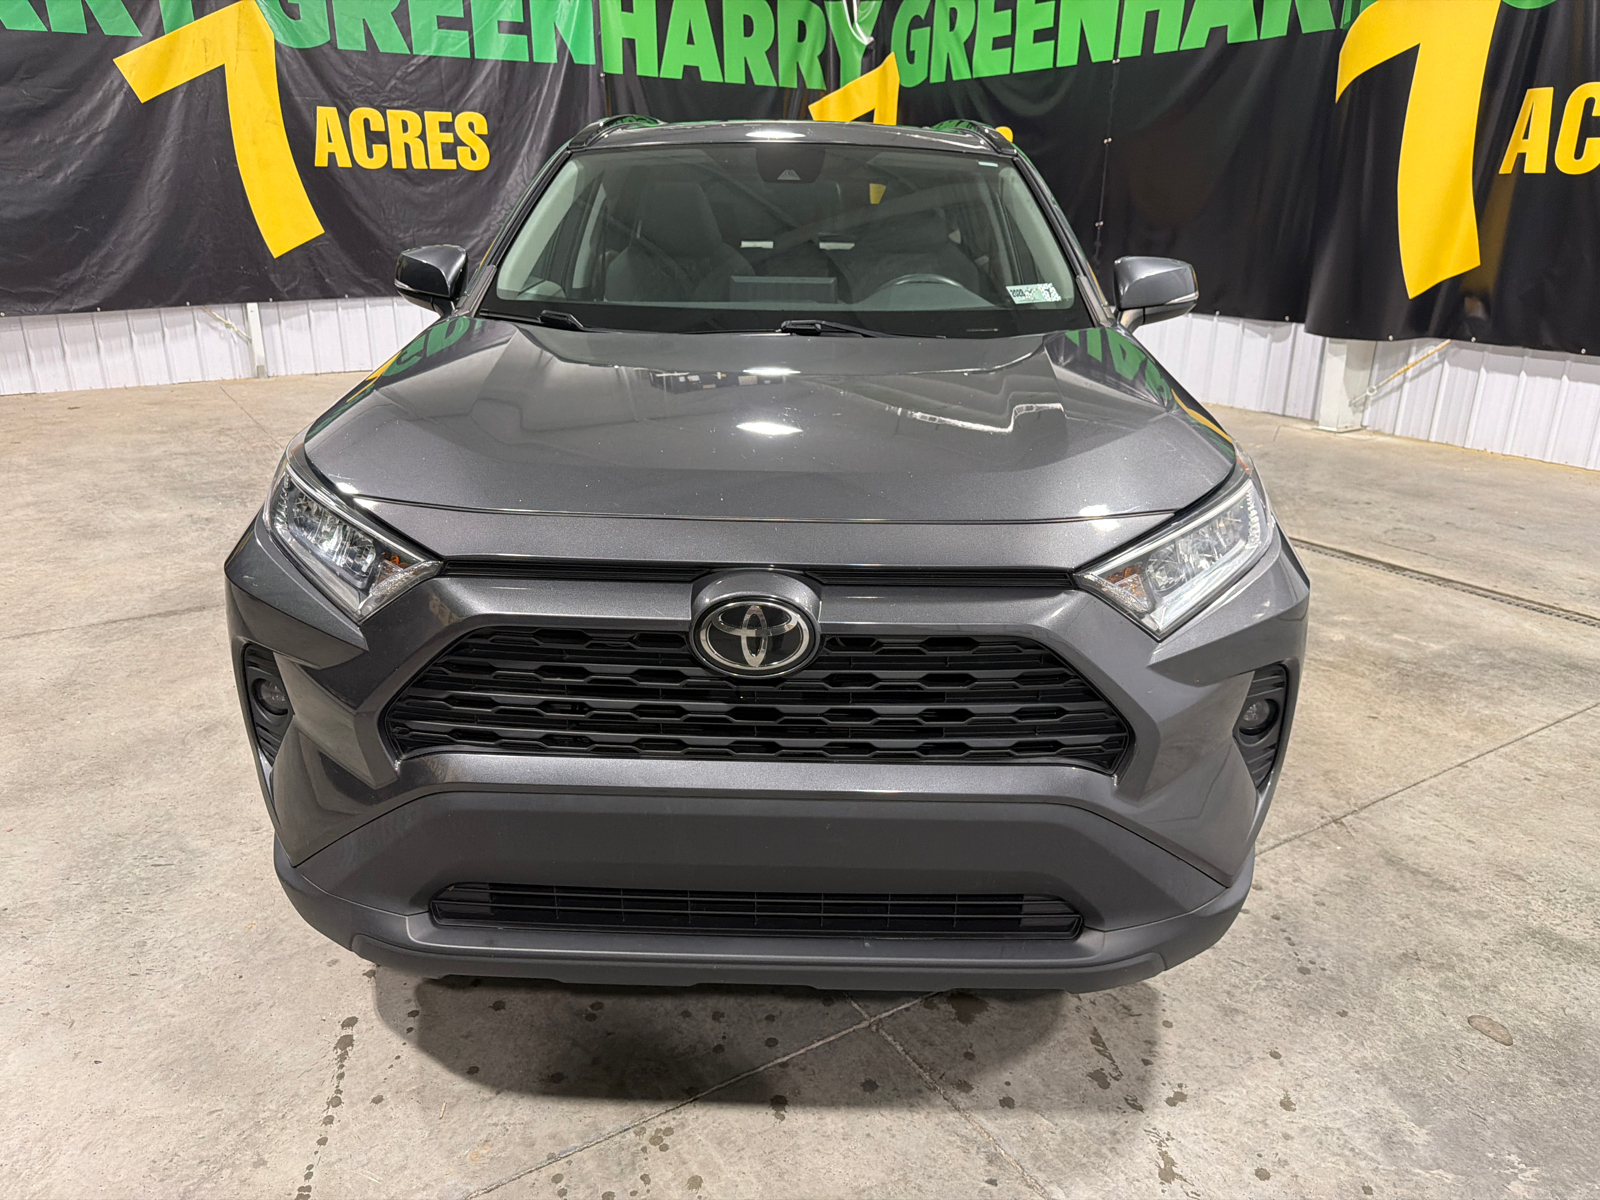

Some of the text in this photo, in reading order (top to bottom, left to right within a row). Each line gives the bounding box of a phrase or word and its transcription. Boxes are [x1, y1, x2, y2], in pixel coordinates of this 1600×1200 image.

[113, 0, 491, 259] 7 ACRES
[600, 0, 882, 90] HARRY
[890, 0, 1119, 88] GREEN
[1336, 0, 1500, 299] 7
